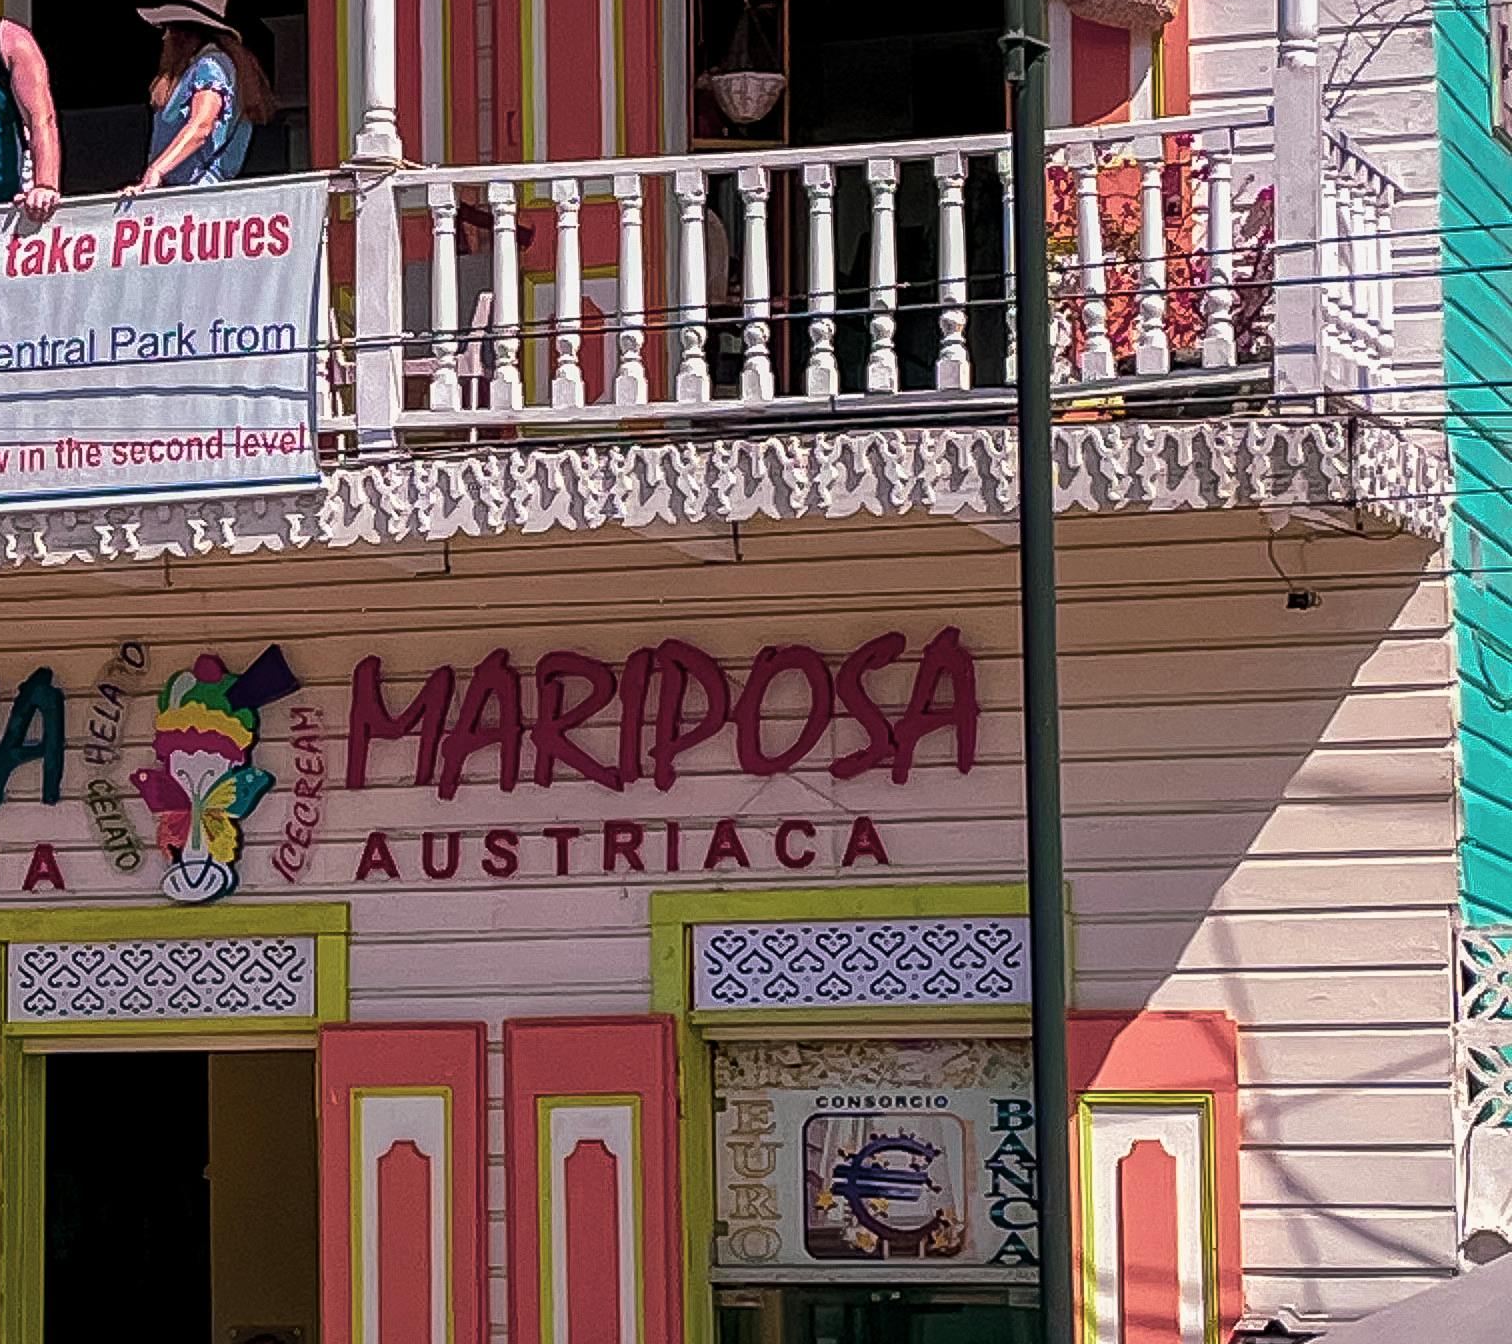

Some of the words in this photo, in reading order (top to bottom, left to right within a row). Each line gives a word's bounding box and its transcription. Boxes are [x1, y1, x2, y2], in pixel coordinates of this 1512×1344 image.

[5, 225, 97, 278] take
[111, 213, 291, 268] Pictures
[110, 322, 198, 359] Park
[208, 318, 296, 354] from
[18, 445, 45, 472] in
[55, 436, 102, 469] the
[111, 427, 224, 465] second
[235, 421, 306, 459] level
[346, 626, 981, 801] MARIPOSA
[355, 816, 889, 881] AUSTRIACA
[816, 1095, 949, 1109] CONSORCIO
[726, 1099, 784, 1261] EURO
[984, 1097, 1038, 1265] BANCA
